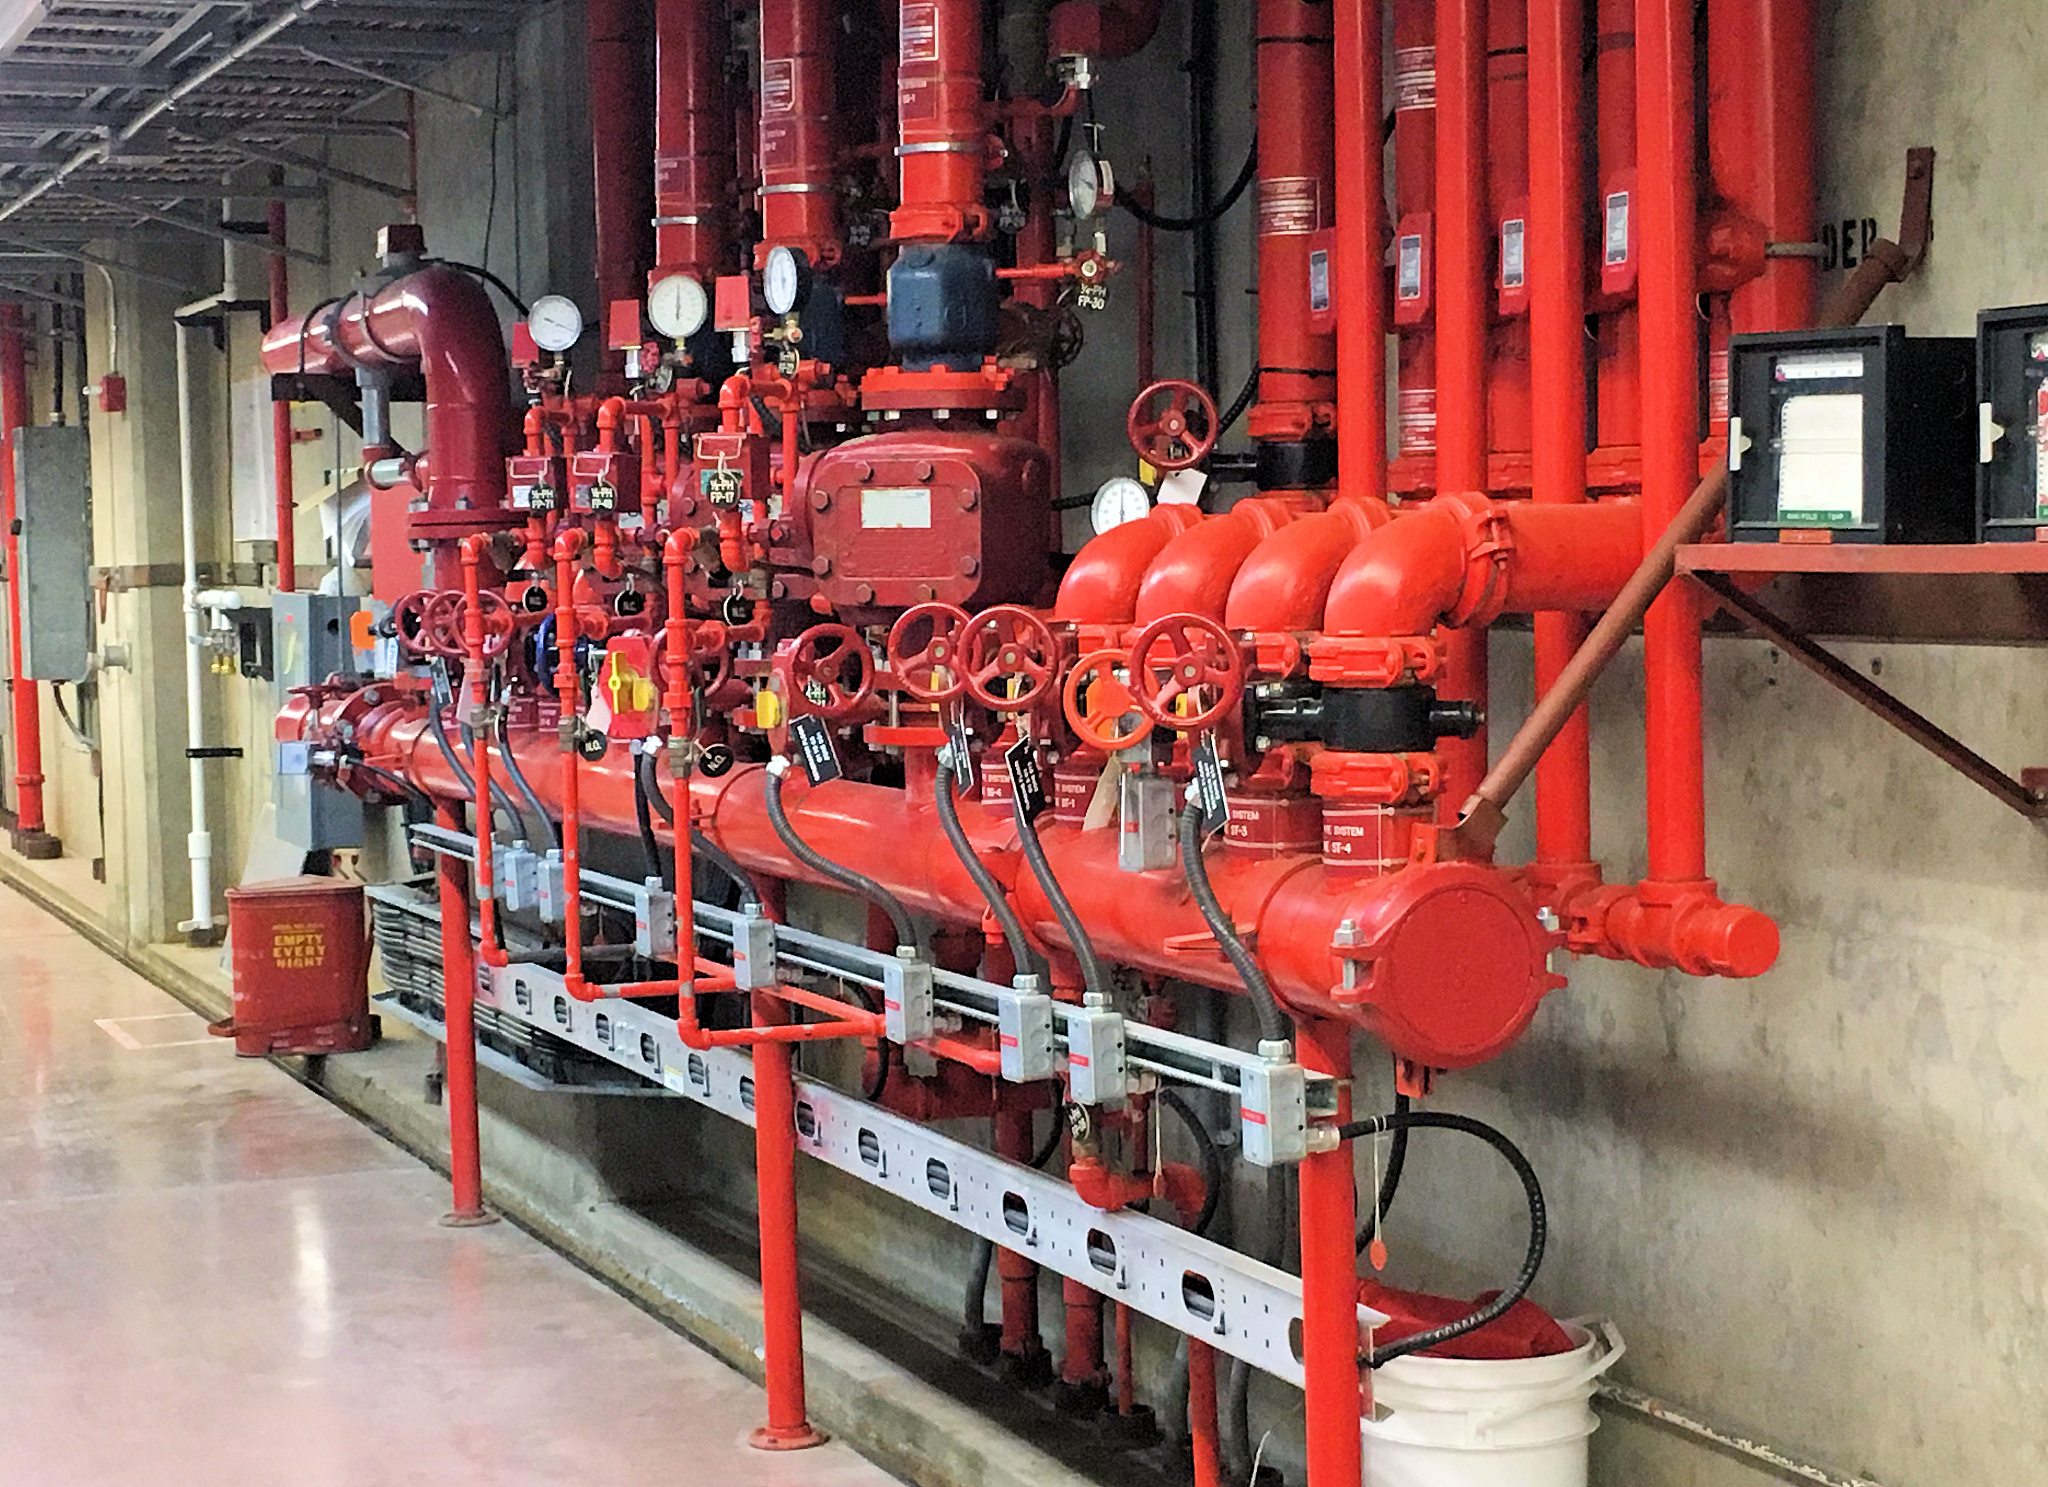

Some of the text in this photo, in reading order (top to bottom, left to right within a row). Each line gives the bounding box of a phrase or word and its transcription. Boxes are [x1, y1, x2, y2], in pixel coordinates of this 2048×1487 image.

[1077, 295, 1105, 310] FP-30
[1331, 841, 1352, 854] ST-4
[274, 933, 324, 946] EMPTY
[272, 945, 326, 958] EVERY
[276, 956, 323, 969] NIGHT
